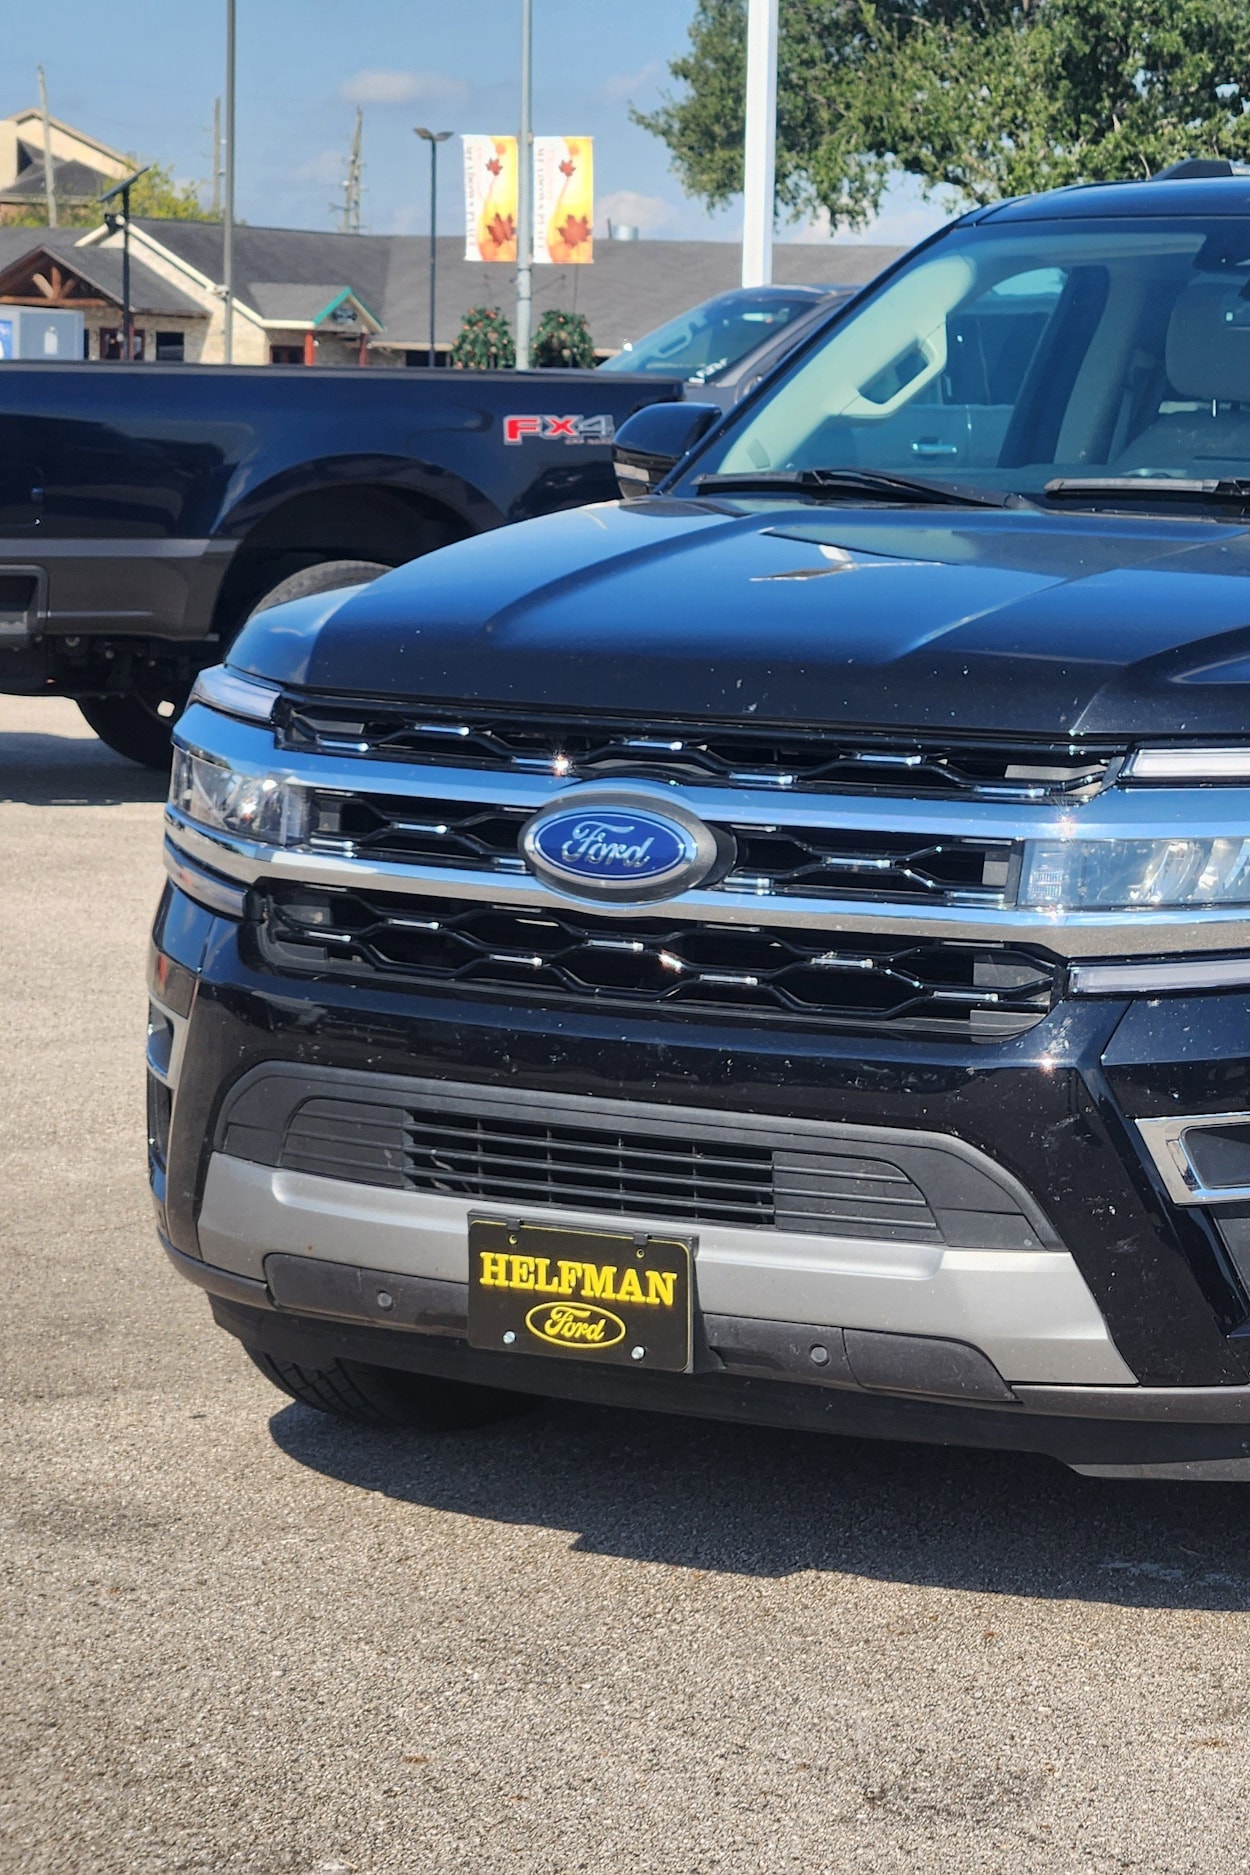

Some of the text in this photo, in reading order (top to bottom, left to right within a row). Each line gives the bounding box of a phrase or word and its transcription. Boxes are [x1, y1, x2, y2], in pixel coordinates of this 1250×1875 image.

[503, 414, 615, 445] FX4
[561, 820, 655, 868] Ford
[479, 1251, 678, 1306] HELFMAN
[543, 1306, 606, 1341] Ford
